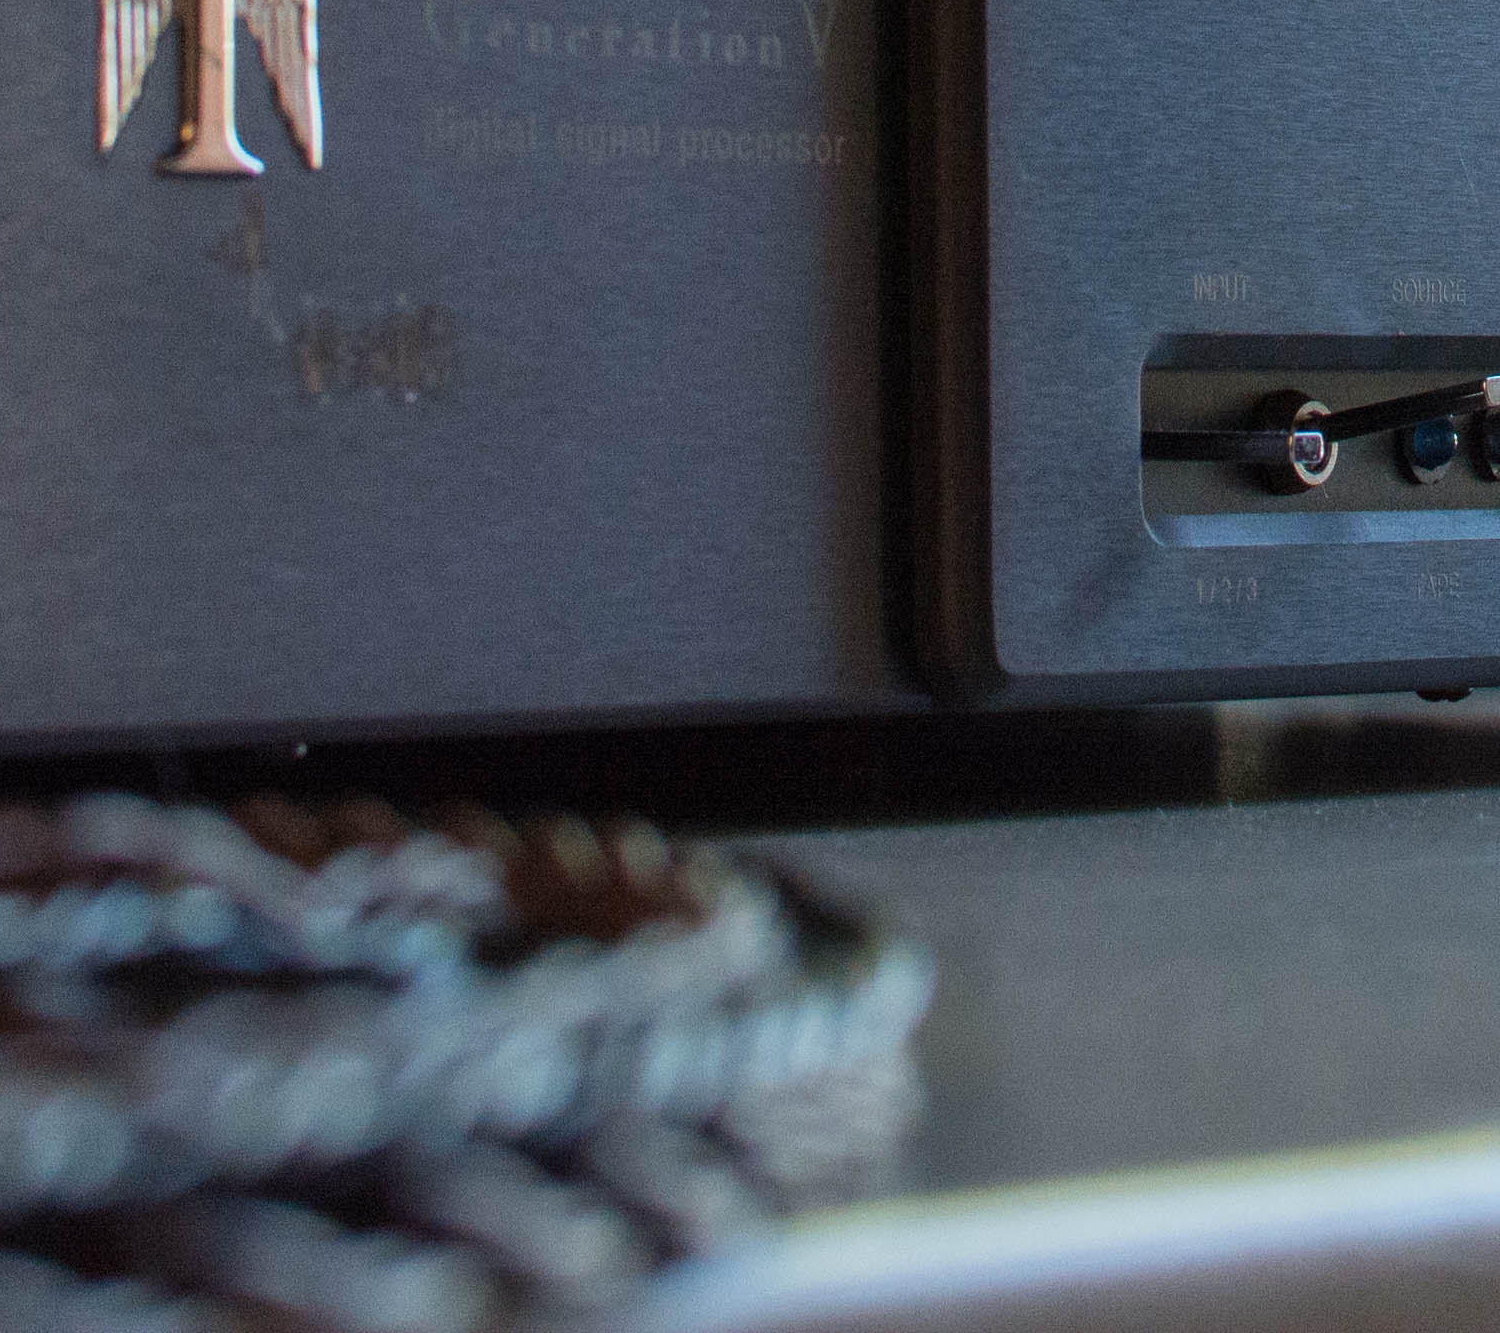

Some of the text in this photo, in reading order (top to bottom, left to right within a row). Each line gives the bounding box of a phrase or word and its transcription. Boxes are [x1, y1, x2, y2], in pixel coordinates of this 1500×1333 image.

[677, 130, 847, 168] processor
[1192, 274, 1250, 302] INPUT
[1391, 276, 1468, 304] SOURCE
